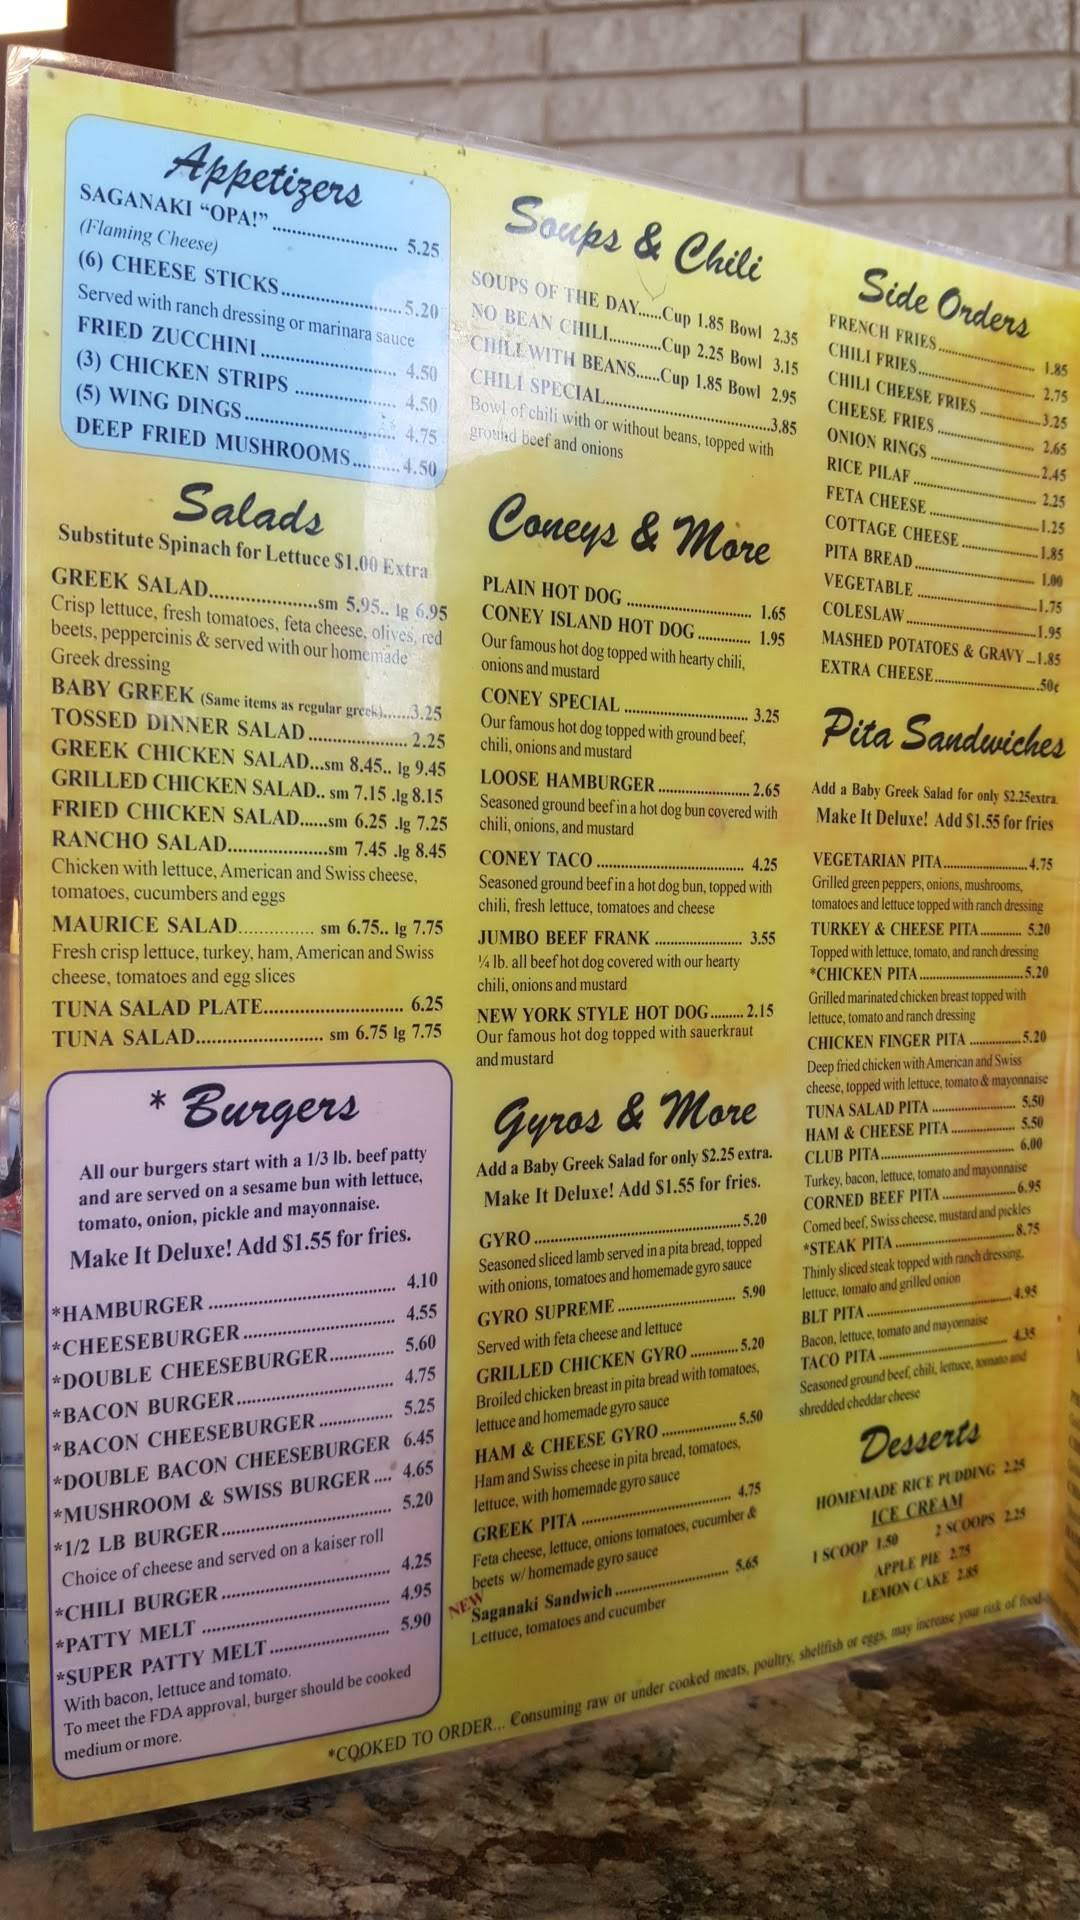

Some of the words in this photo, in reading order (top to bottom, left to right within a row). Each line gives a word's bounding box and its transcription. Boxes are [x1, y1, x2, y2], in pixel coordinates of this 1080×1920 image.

[163, 142, 363, 213] Appetizers
[80, 184, 192, 216] SAGANAKI
[407, 239, 440, 258] 5.25
[80, 218, 152, 246] (Flaming
[158, 230, 218, 254] Cheese)
[505, 195, 622, 257] Soups
[633, 222, 663, 261] &
[674, 231, 763, 282] Chili
[78, 284, 133, 306] Served
[138, 295, 172, 312] with
[176, 300, 218, 318] ranch
[222, 305, 285, 331] dressing
[289, 317, 305, 330] or
[308, 321, 372, 342] marinara
[376, 330, 415, 348] sauce
[858, 268, 929, 315] Side
[937, 287, 1030, 338] Orders
[78, 316, 142, 340] FRIED
[152, 326, 257, 356] ZUCCHINI
[406, 365, 438, 383] 4.50
[698, 313, 724, 332] 1.85
[730, 319, 762, 340] Bowl
[773, 328, 798, 346] 2.35
[829, 313, 889, 340] FRENCH
[896, 328, 936, 351] FRIES
[1044, 361, 1068, 376] 1.85
[697, 344, 724, 362] 2.25
[730, 350, 762, 370] Bowl
[773, 359, 799, 375] 3.15
[828, 370, 870, 392] CHILI
[876, 380, 932, 405] CHEESE
[937, 393, 976, 413] FRIES
[554, 437, 577, 451] and
[581, 442, 623, 459] onions
[563, 411, 590, 429] with
[595, 418, 609, 430] or
[612, 419, 659, 440] without
[663, 427, 701, 446] beans,
[705, 431, 744, 454] topped
[748, 440, 774, 456] with
[173, 482, 325, 536] Salads
[488, 492, 619, 557] Coneys
[631, 511, 660, 552] &
[673, 515, 771, 566] More
[58, 524, 154, 549] Substitute
[159, 535, 231, 560] Spinach
[236, 543, 261, 560] for
[266, 547, 329, 568] Lettuce
[334, 553, 378, 573] $1.00
[383, 559, 428, 579] Extra
[825, 544, 858, 562] PITA
[864, 548, 912, 568] BREAD
[1042, 573, 1063, 587] 1.00
[483, 575, 535, 596] PLAIN
[542, 581, 579, 600] HOT
[585, 586, 622, 605] DOG
[760, 605, 786, 621] 1.65
[824, 572, 913, 597] VEGETABLE
[822, 630, 883, 649] MASHED
[888, 636, 958, 656] POTATOES
[964, 644, 974, 658] &
[979, 645, 1024, 663] GRAVY
[52, 708, 137, 730] TOSSED
[147, 714, 229, 736] DINNER
[237, 720, 305, 740] SALAD
[412, 733, 446, 749] 2.25
[822, 707, 893, 748] Pita
[901, 714, 1066, 759] Sandwiches
[816, 807, 856, 825] Make
[861, 809, 872, 825] It
[876, 809, 928, 827] Deluxe!
[934, 812, 962, 828] Add
[966, 812, 1000, 829] $1.55
[1003, 814, 1022, 830] for
[1025, 815, 1054, 831] fries
[479, 898, 510, 914] chili,
[515, 898, 544, 913] fresh
[550, 900, 593, 915] lettuce,
[597, 901, 650, 914] tomatoes
[653, 902, 674, 914] and
[678, 901, 715, 915] cheese
[478, 929, 539, 945] JUMBO
[546, 930, 588, 945] BEEF
[595, 930, 650, 945] FRANK
[750, 932, 776, 945] 3.55
[811, 922, 870, 936] TURKEY
[874, 923, 885, 936] &
[891, 922, 944, 936] CHEESE
[1027, 923, 1050, 936] 5.20
[808, 1011, 846, 1026] lettuce,
[848, 1009, 883, 1023] tomato
[886, 1010, 904, 1022] and
[906, 1008, 933, 1022] ranch
[935, 1008, 976, 1024] dressing
[807, 1035, 874, 1051] CHICKEN
[879, 1033, 931, 1049] FINGER
[936, 1032, 966, 1047] PITA
[182, 1083, 360, 1139] Burgers
[494, 1096, 603, 1153] Gyros
[616, 1092, 645, 1132] &
[660, 1089, 757, 1130] More
[79, 1164, 105, 1181] All
[110, 1163, 139, 1179] our
[144, 1160, 208, 1181] burgers
[212, 1159, 249, 1174] start
[254, 1152, 288, 1169] with
[293, 1155, 301, 1167] a
[307, 1150, 328, 1167] 1/3
[333, 1149, 352, 1165] lb.
[356, 1147, 388, 1164] beef
[391, 1146, 427, 1166] patty
[476, 1161, 506, 1178] Add
[511, 1164, 519, 1176] a
[523, 1158, 559, 1177] Baby
[562, 1154, 604, 1172] Greek
[608, 1151, 645, 1168] Salad
[649, 1150, 668, 1166] for
[671, 1151, 699, 1167] only
[701, 1147, 735, 1163] $2.25
[737, 1146, 772, 1161] extra.
[479, 1230, 531, 1249] GYRO
[158, 1455, 227, 1480] BACON
[235, 1434, 390, 1469] CHEESEBURGER
[403, 1428, 435, 1448] 6.45
[860, 1419, 981, 1465] Desserts
[816, 1482, 897, 1511] HOMEMADE
[902, 1475, 934, 1493] RICE
[938, 1463, 996, 1486] PUDDING
[872, 1507, 899, 1527] ICE
[906, 1493, 964, 1521] CREAM
[62, 1566, 118, 1588] Choice
[122, 1564, 140, 1581] of
[142, 1558, 193, 1577] cheese
[197, 1553, 225, 1570] and
[228, 1545, 276, 1566] served
[280, 1543, 298, 1557] on
[302, 1542, 310, 1554] a
[314, 1531, 356, 1552] kaiser
[360, 1527, 384, 1545] roll
[874, 1555, 916, 1579] APPLE
[921, 1551, 941, 1566] PIE
[448, 1589, 485, 1619] NEW
[471, 1596, 539, 1625] Saganaki
[544, 1584, 612, 1609] Sandwich
[862, 1581, 910, 1604] LEMON
[914, 1571, 950, 1591] CAKE
[510, 1698, 582, 1728] Consuming
[586, 1694, 609, 1711] raw
[613, 1691, 627, 1704] or
[631, 1683, 665, 1701] under
